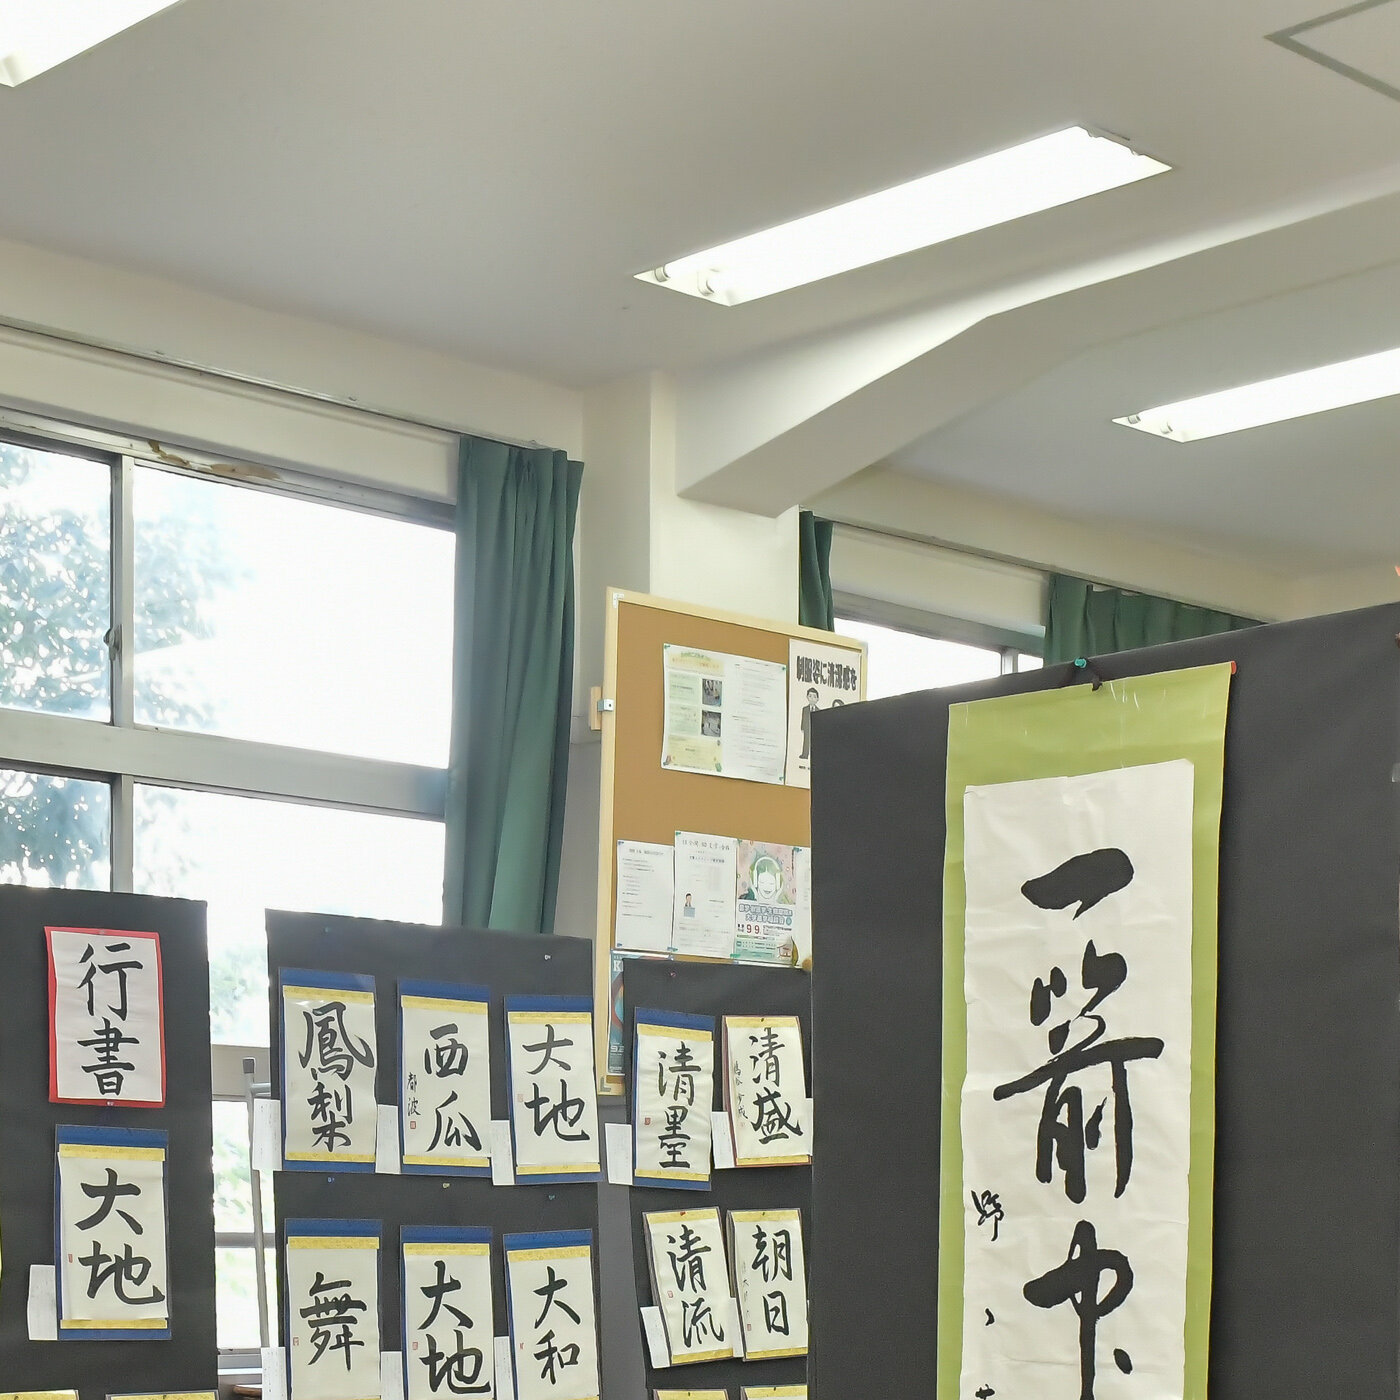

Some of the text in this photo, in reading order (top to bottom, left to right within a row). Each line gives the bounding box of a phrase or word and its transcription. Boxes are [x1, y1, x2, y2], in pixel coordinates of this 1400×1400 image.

[76, 942, 144, 1096] 行書
[298, 1001, 375, 1152] 鳳梨
[424, 1023, 482, 1152] 西瓜
[521, 1024, 591, 1141] 大地
[749, 1027, 804, 1146] 清盛
[75, 1167, 166, 1305] 大地
[666, 1224, 725, 1349] 清流
[751, 1224, 793, 1336] 朝日
[299, 1271, 367, 1371] 舞
[418, 1260, 492, 1395] 大地
[533, 1266, 581, 1385] 大和
